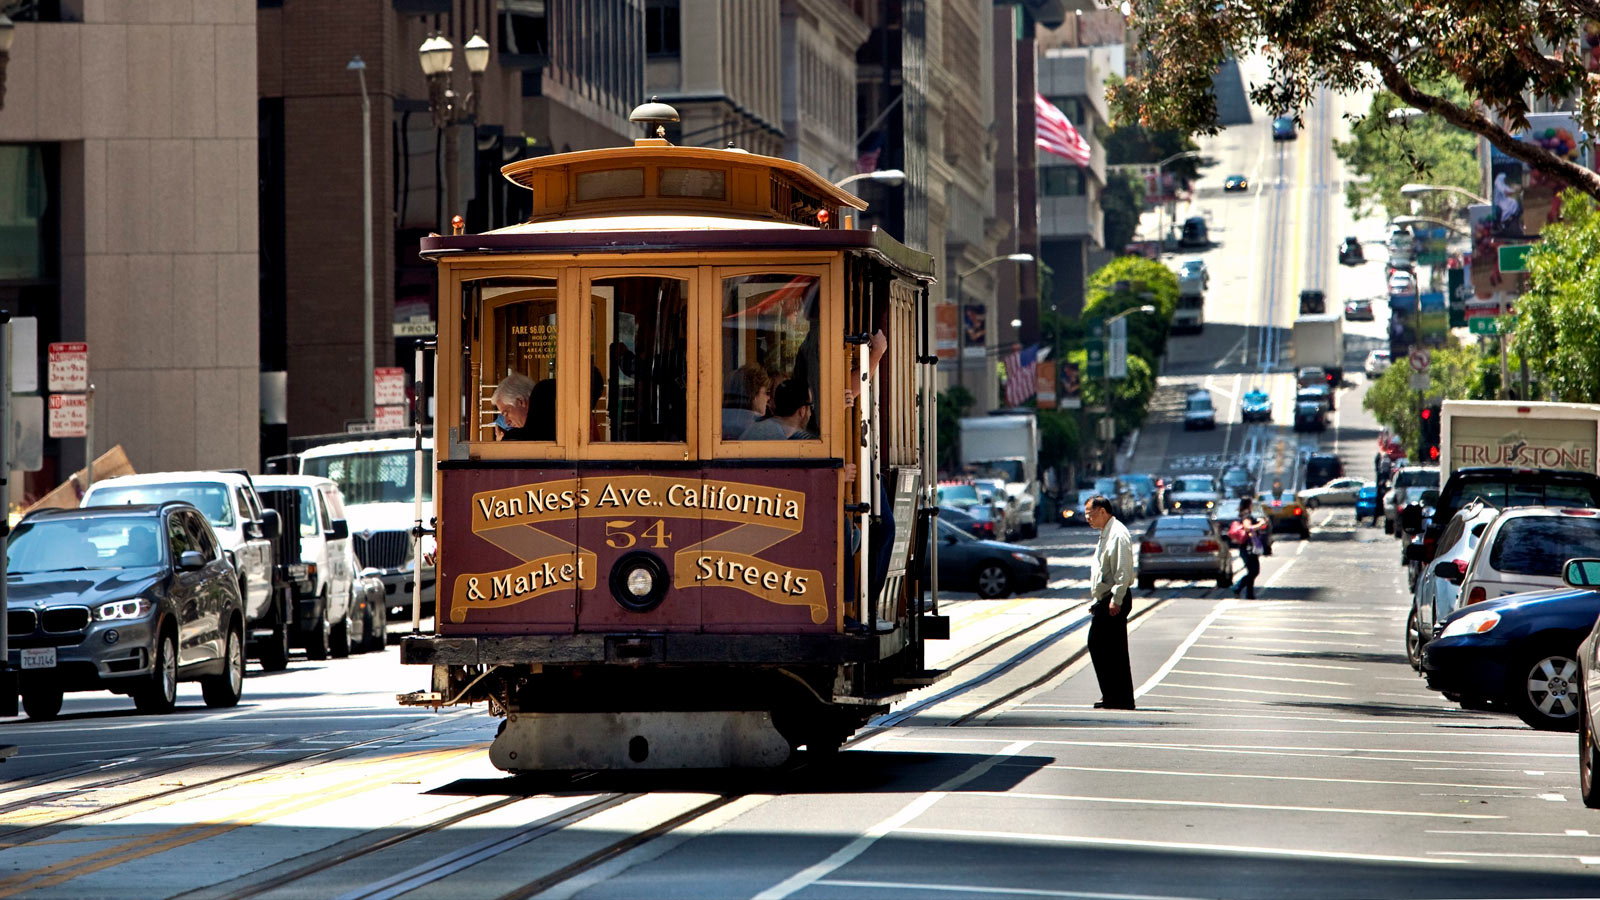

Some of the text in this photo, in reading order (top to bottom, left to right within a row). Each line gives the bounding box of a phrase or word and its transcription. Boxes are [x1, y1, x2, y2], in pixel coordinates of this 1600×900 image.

[511, 326, 528, 334] FARE
[478, 496, 523, 521] Van
[526, 488, 590, 514] Ness
[667, 484, 799, 520] California
[605, 519, 673, 549] 54
[466, 556, 809, 601] & Market Streets
